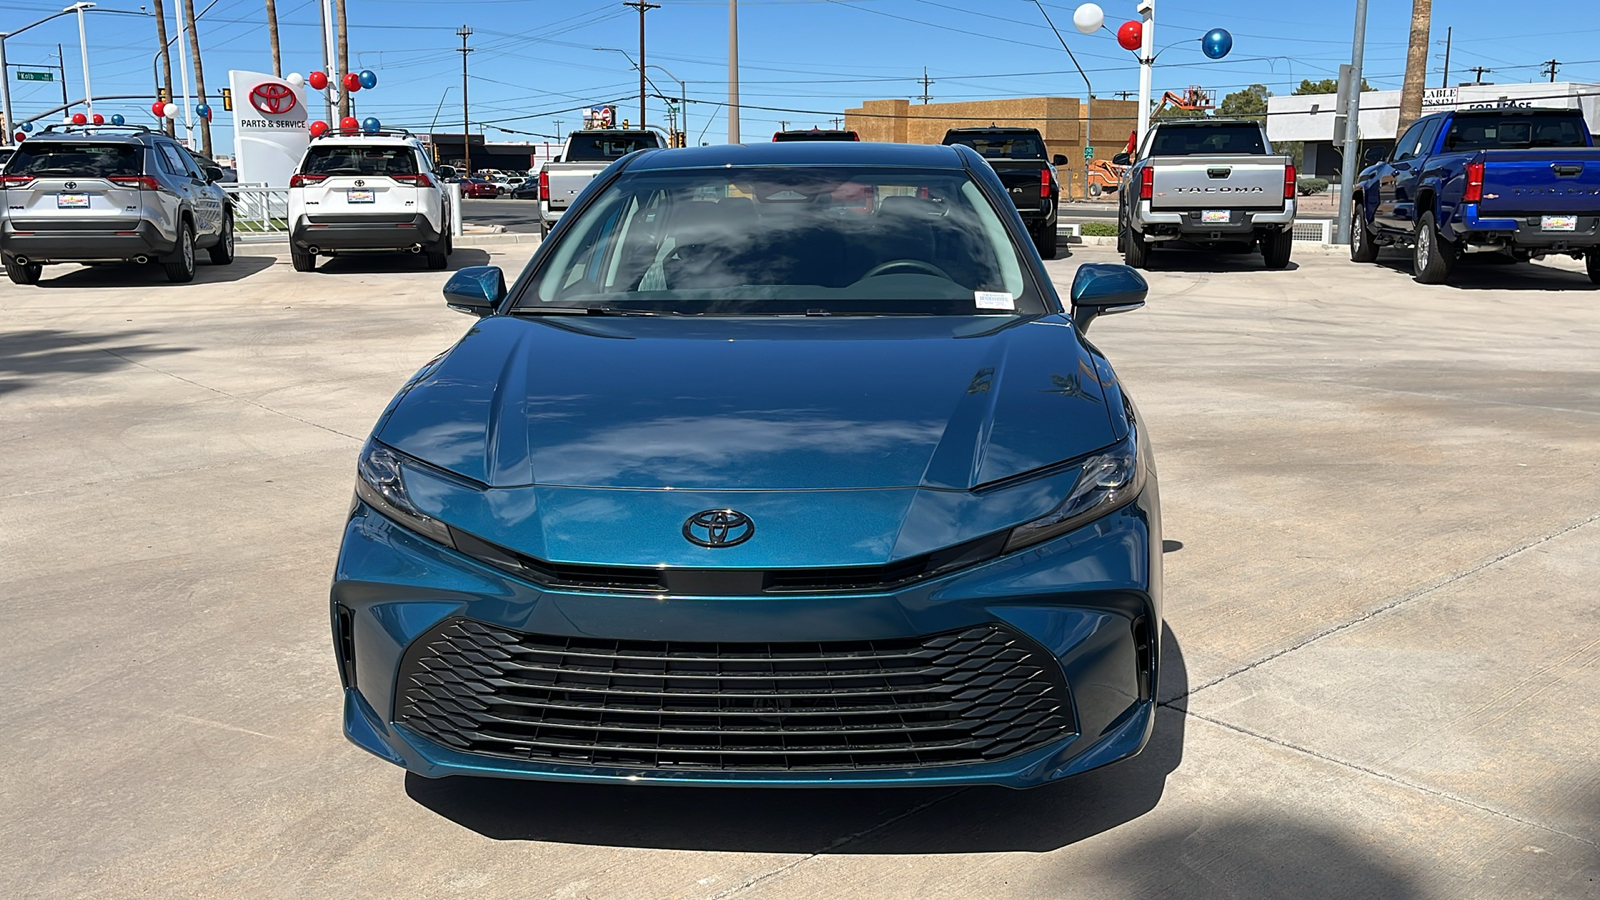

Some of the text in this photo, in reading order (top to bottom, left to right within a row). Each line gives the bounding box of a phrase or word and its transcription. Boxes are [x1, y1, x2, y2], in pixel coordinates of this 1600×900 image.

[20, 72, 34, 80] Kolb
[241, 119, 306, 129] PARTS & SERVICE
[1174, 186, 1264, 194] TACOMA
